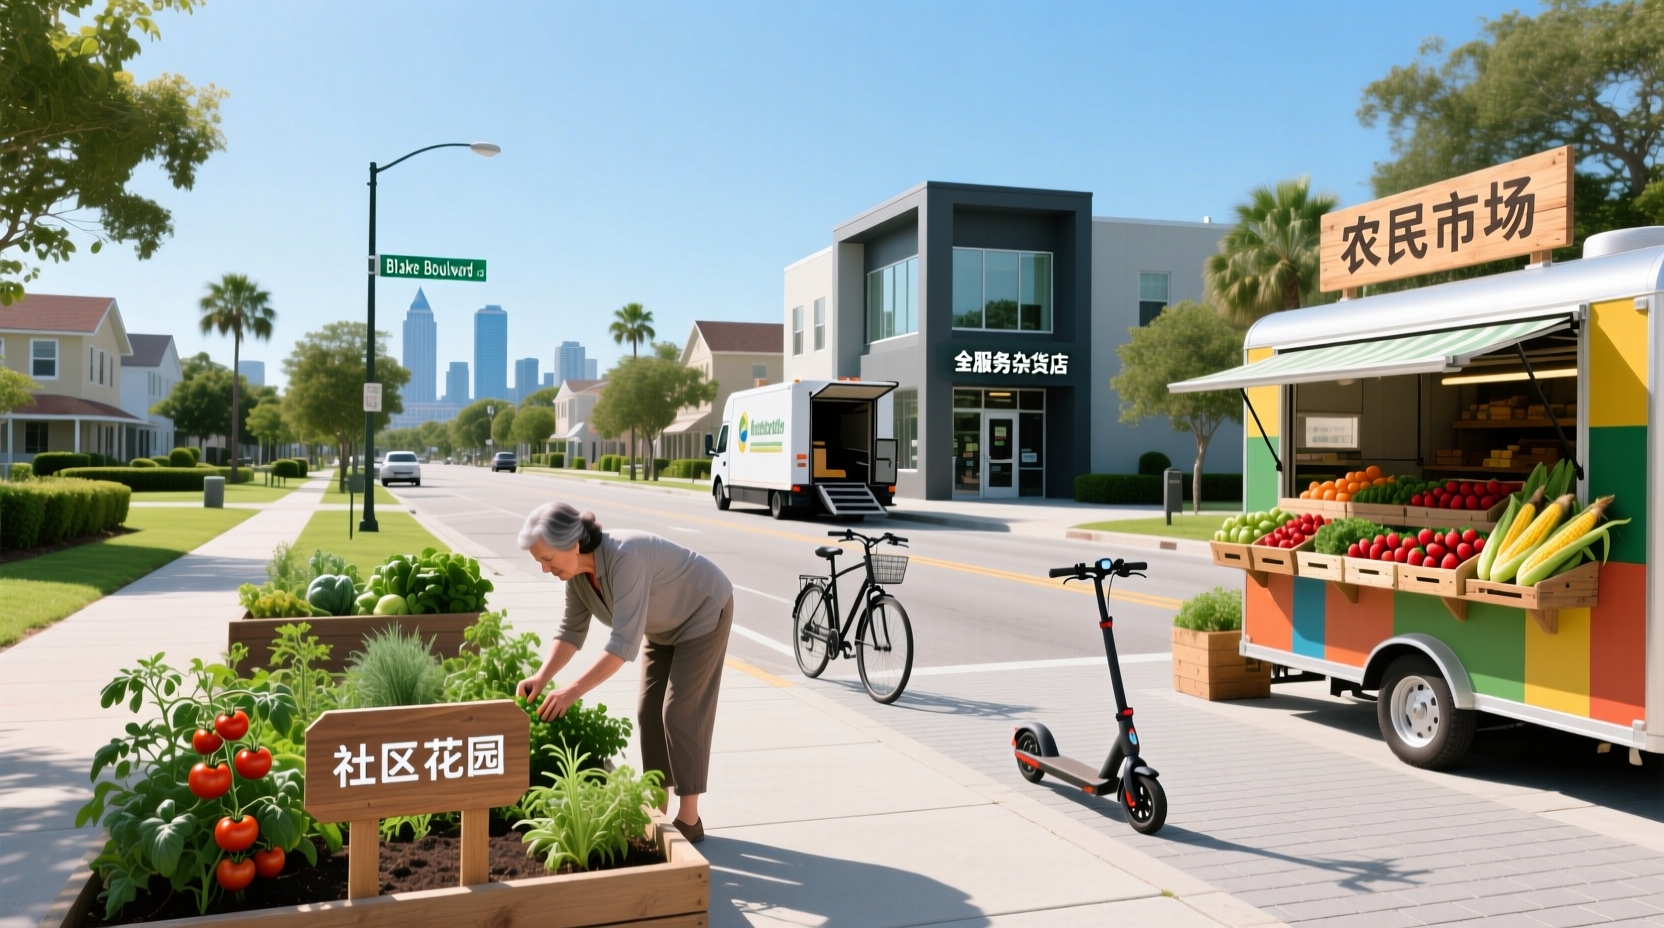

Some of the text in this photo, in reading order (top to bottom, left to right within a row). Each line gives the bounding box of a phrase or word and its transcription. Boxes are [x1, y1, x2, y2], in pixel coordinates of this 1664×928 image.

[1340, 175, 1536, 275] 农民市场
[386, 258, 420, 274] Blake
[954, 349, 1069, 375] 全服务杂货店
[332, 734, 505, 789] 社区花园
